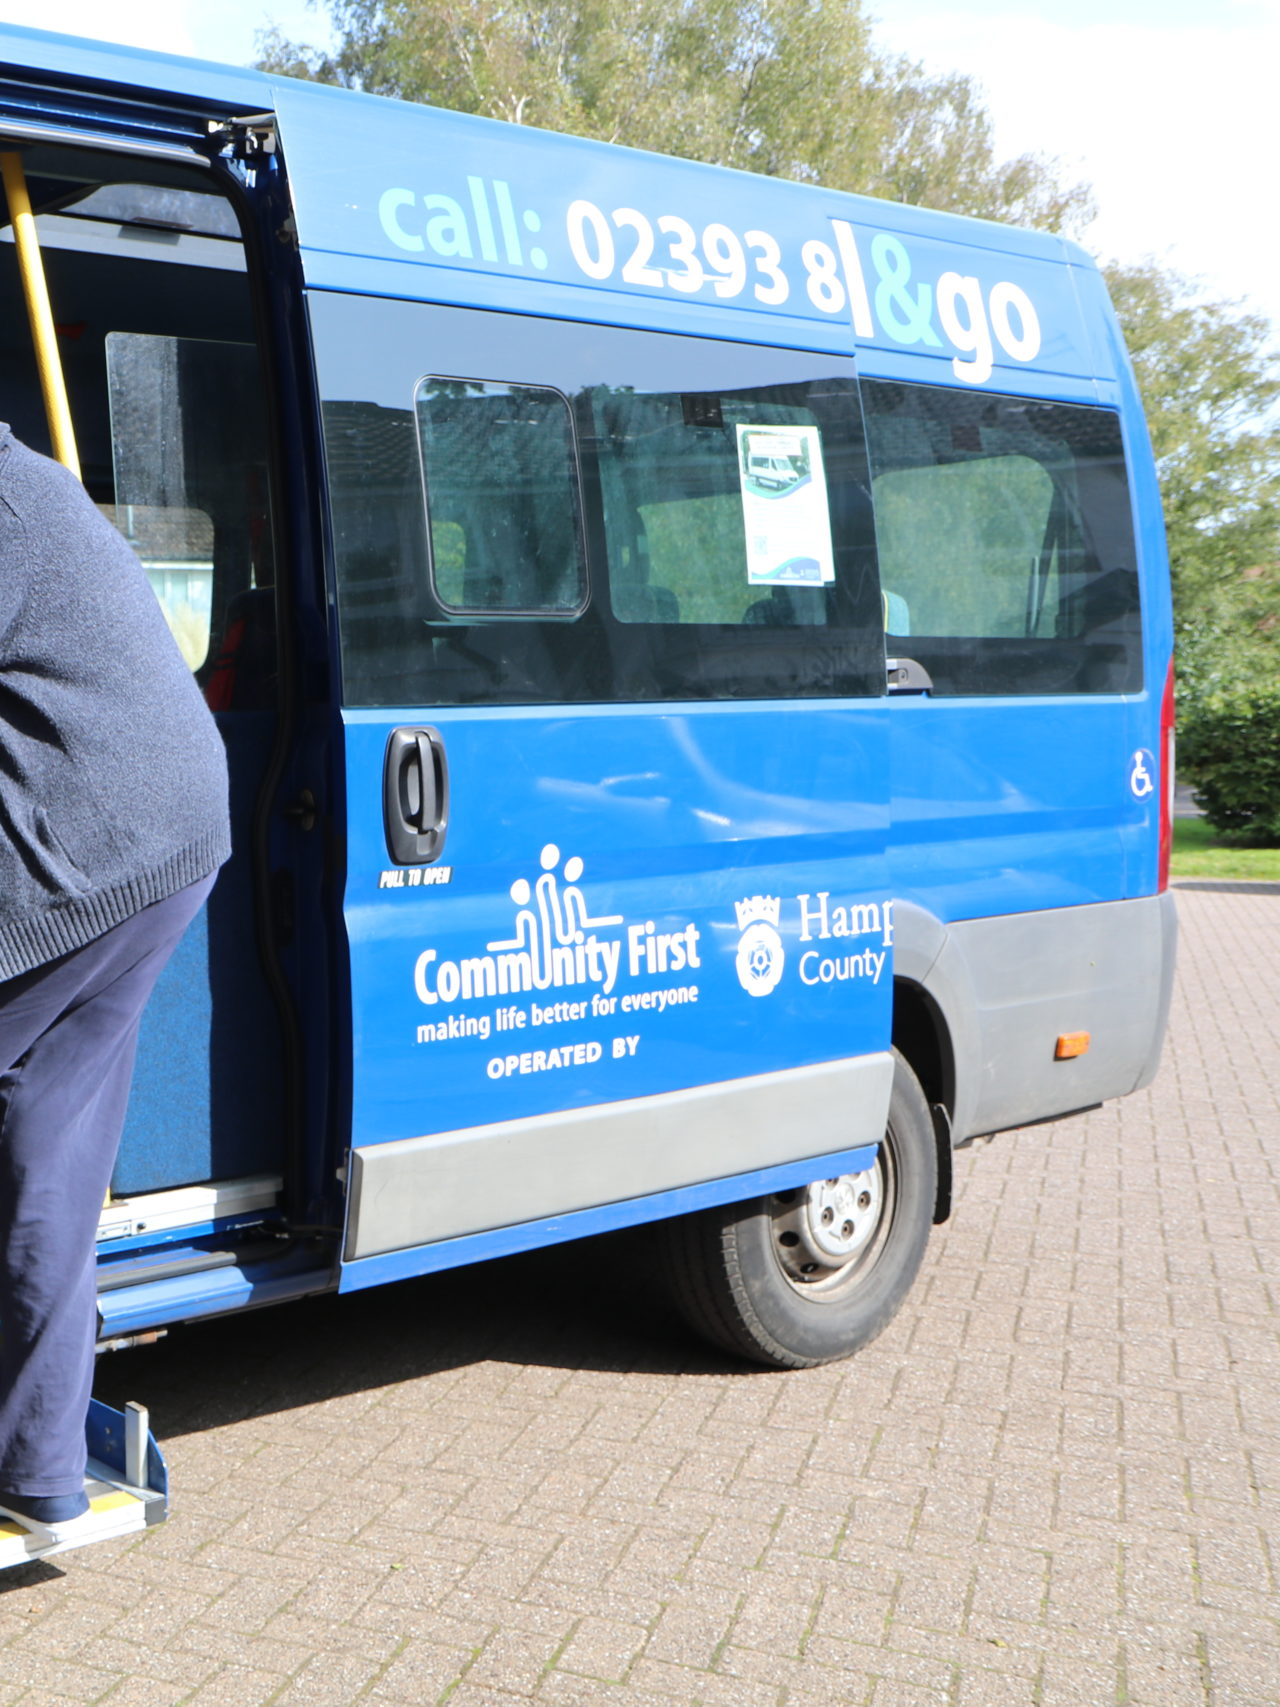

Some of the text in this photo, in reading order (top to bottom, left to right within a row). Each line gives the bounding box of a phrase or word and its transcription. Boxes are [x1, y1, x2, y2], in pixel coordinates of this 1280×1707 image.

[379, 175, 548, 270] call:
[566, 200, 789, 304] 02393
[380, 866, 451, 889] PULL TO OPEN
[628, 921, 701, 977] First
[799, 947, 886, 986] County
[417, 983, 699, 1045] making life better for everyone
[486, 1035, 640, 1080] OPERATED BY
